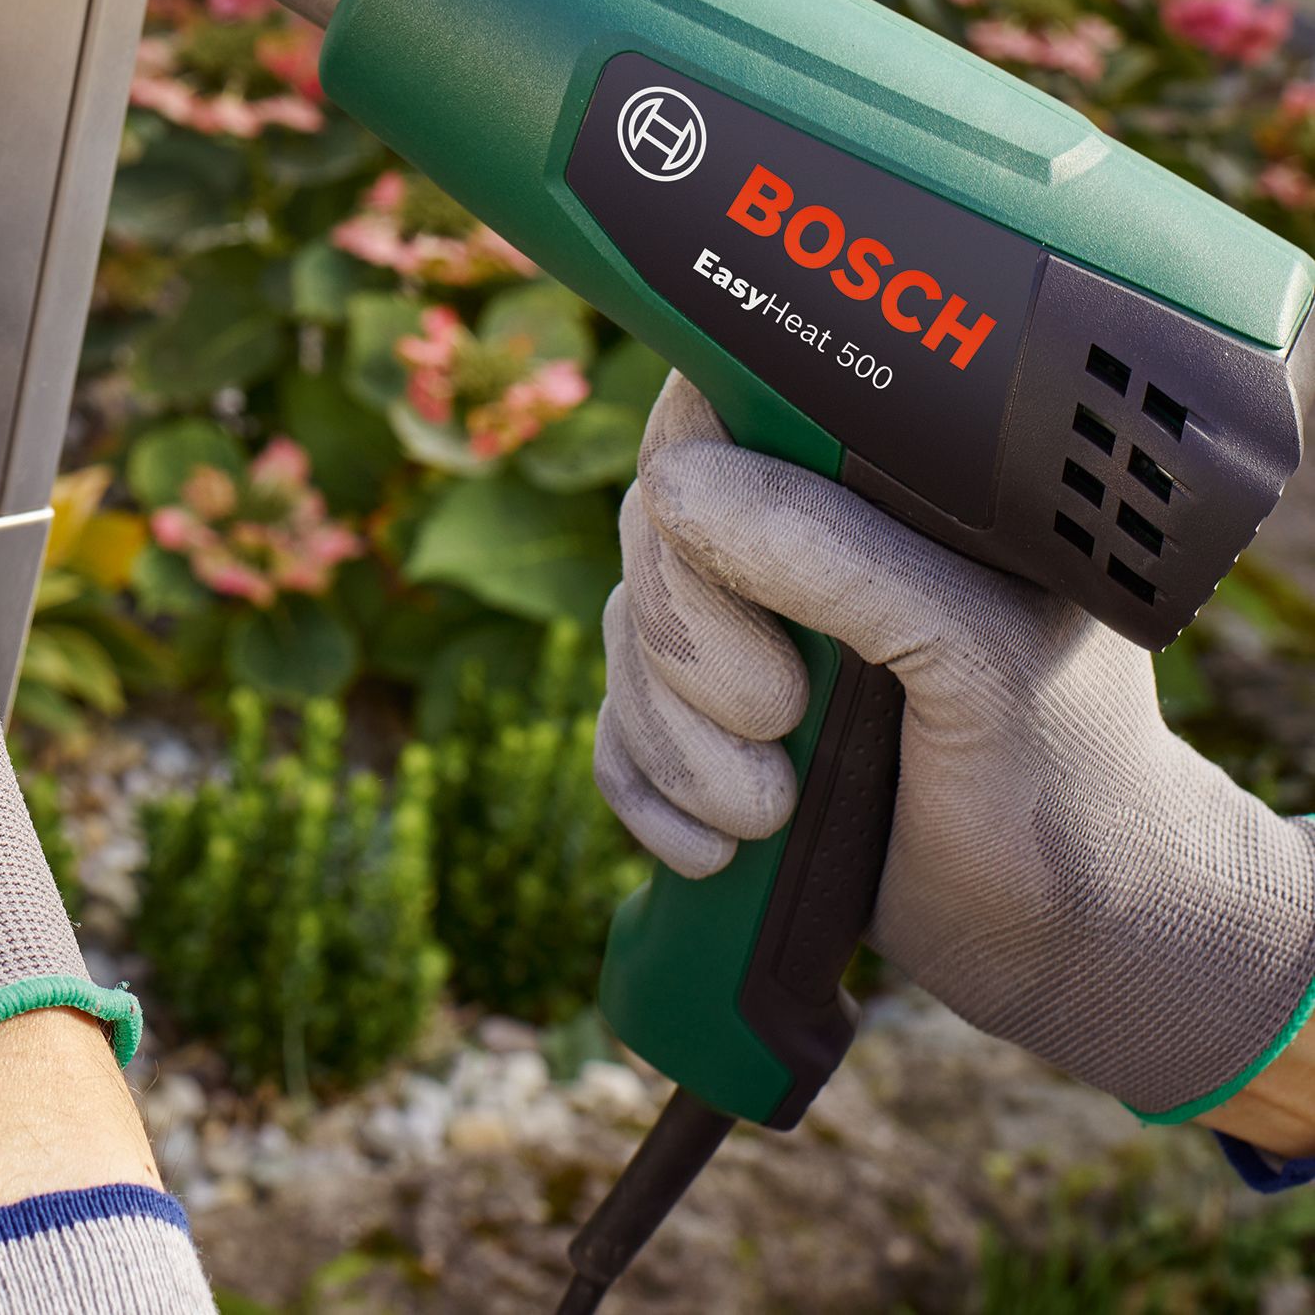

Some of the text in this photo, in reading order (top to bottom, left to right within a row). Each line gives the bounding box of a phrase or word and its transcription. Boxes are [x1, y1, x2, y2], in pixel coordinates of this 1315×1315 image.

[693, 248, 893, 389] EasyHeat 500
[726, 164, 997, 370] BOSCH
